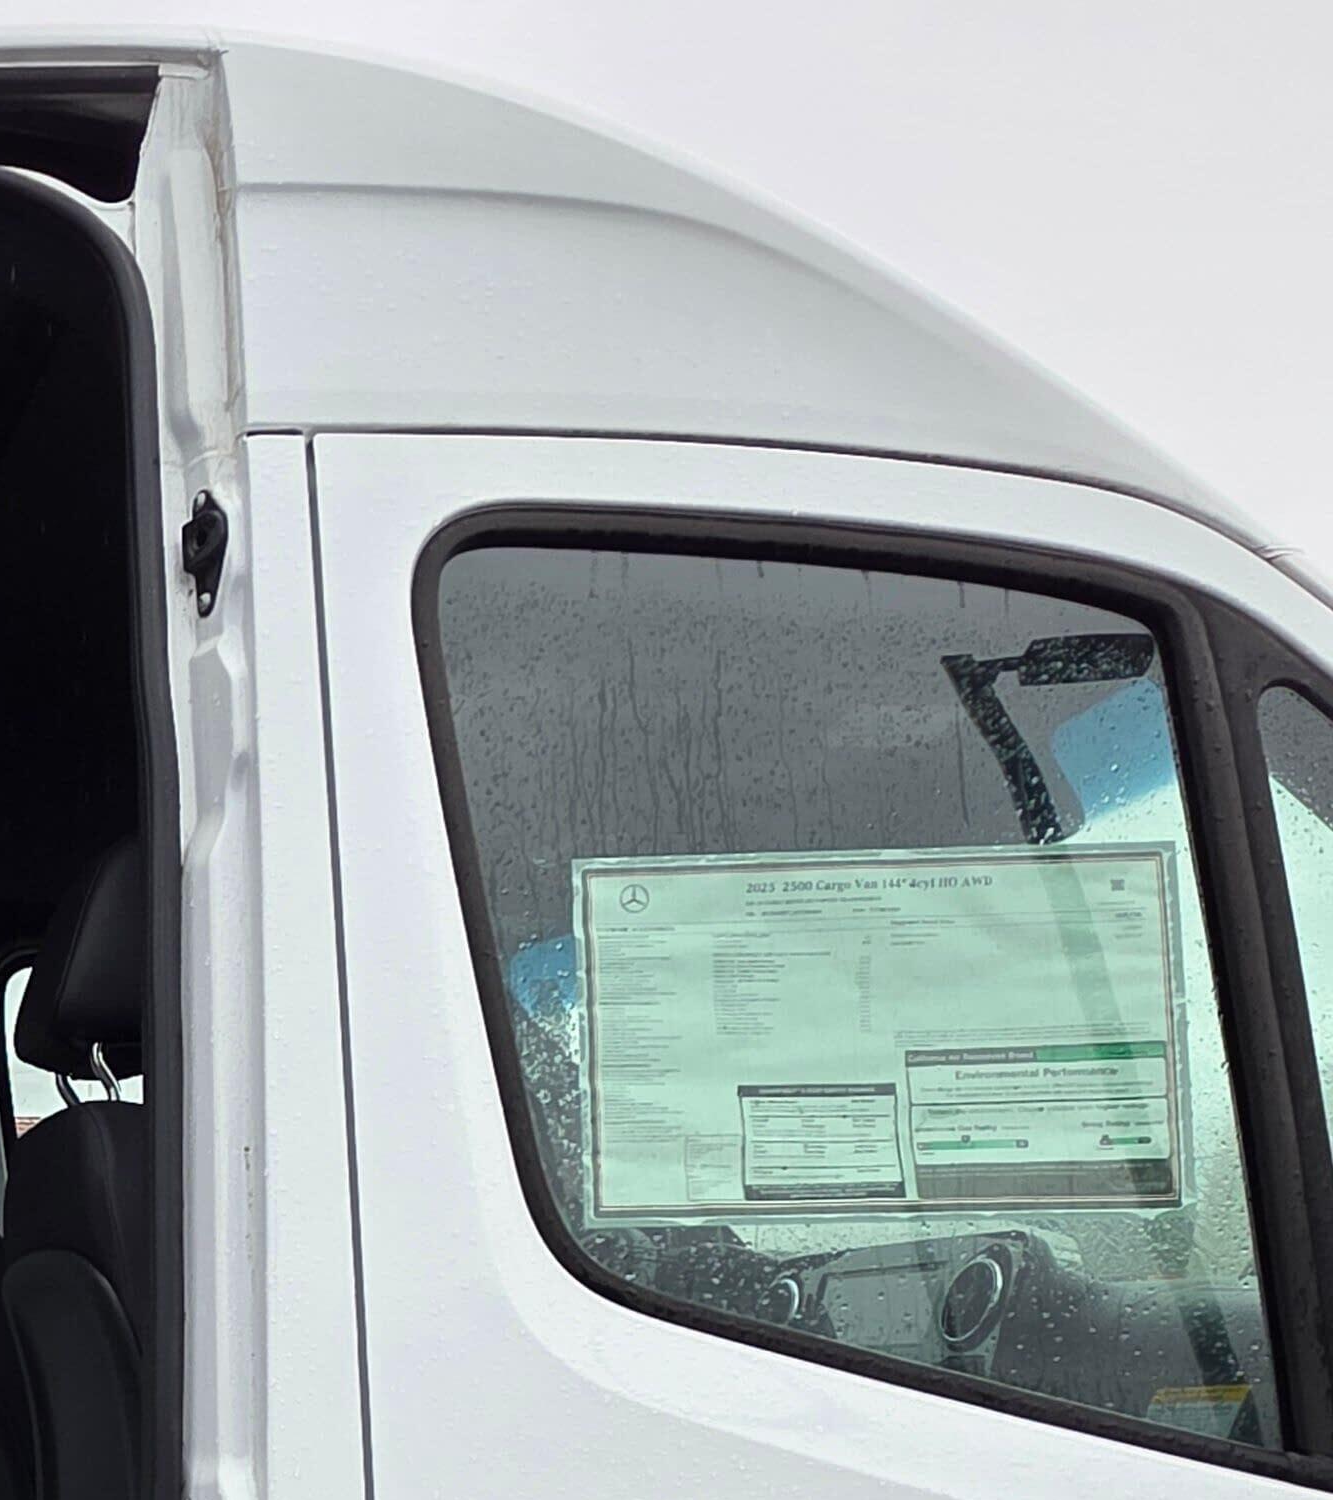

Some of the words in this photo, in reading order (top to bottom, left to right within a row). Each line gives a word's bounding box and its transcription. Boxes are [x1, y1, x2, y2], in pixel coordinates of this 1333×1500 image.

[745, 882, 775, 894] 2025
[782, 880, 814, 892] 2500
[816, 879, 852, 893] Cargo
[854, 878, 878, 889] Van
[961, 875, 993, 888] AWD
